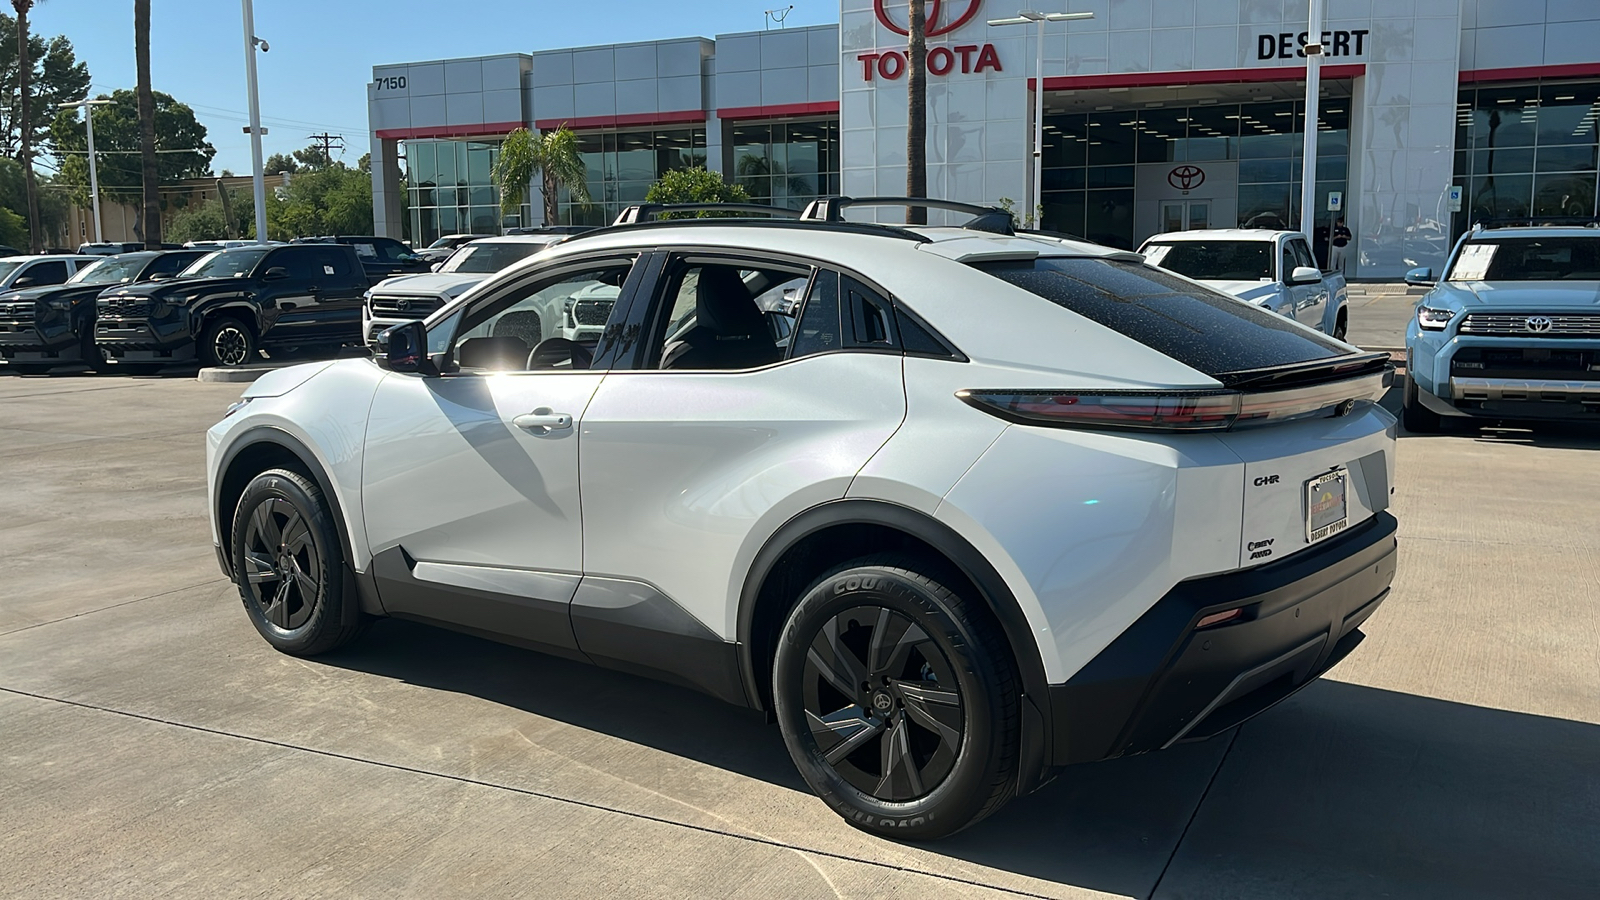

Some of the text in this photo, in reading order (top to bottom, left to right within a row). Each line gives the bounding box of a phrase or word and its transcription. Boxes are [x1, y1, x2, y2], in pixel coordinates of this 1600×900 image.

[1258, 30, 1369, 60] DESERT
[857, 43, 1003, 81] TOOTA
[375, 76, 407, 91] 7150
